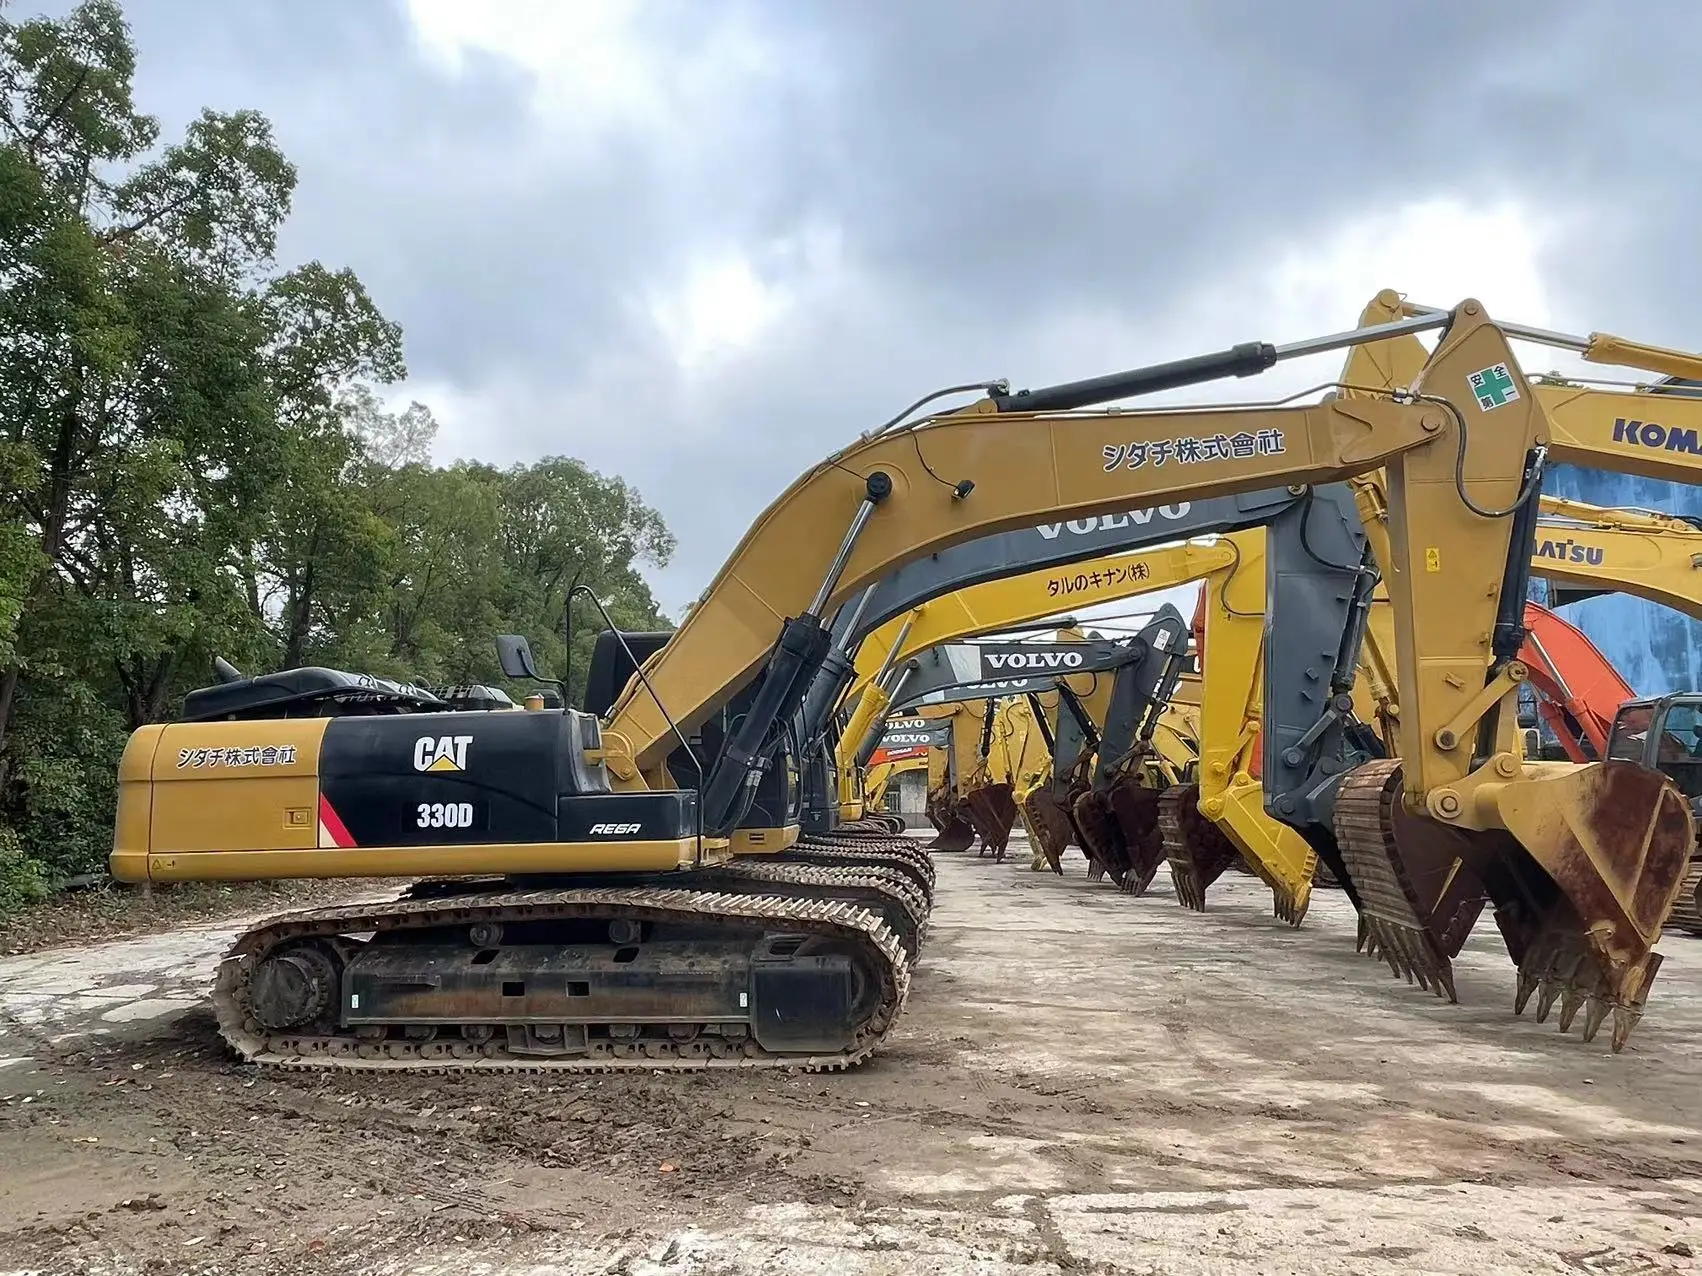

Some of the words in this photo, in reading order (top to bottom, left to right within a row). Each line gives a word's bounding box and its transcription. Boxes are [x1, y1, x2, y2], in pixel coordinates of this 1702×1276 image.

[1103, 429, 1286, 471] シダチ株式會社
[1613, 418, 1702, 455] KOM
[1035, 501, 1191, 540] VOLVO
[1534, 538, 1604, 565] ATSU
[1047, 562, 1150, 597] タルのキナン(株)
[984, 652, 1083, 668] VOLVO
[177, 745, 297, 768] シダチ株式會社
[414, 736, 474, 772] CAT
[417, 803, 474, 828] 330D
[589, 823, 642, 835] REGA
